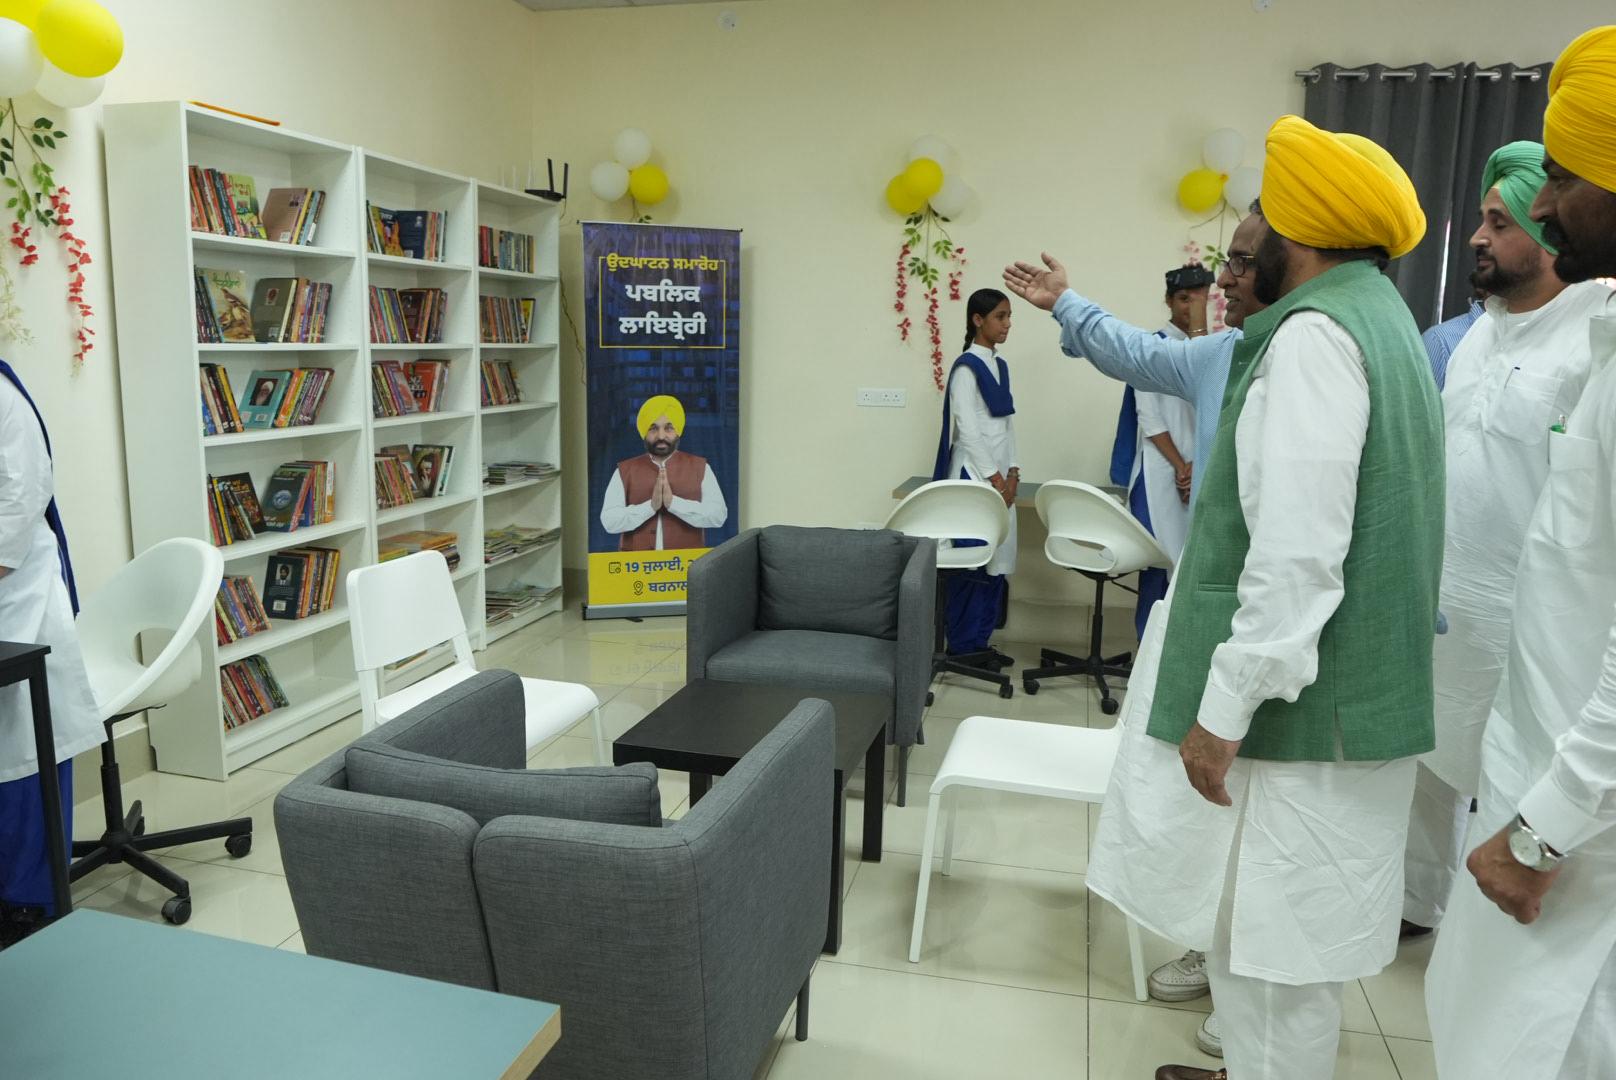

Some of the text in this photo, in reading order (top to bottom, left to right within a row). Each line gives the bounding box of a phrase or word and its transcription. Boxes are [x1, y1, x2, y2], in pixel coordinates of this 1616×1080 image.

[606, 253, 669, 271] ਉਦਘਾਟਨ
[625, 279, 700, 302] ਪਬਲਿਕ
[618, 311, 706, 340] ਲਾਇਬ੍ਰੇਰੀ
[625, 562, 640, 573] 19
[642, 556, 684, 574] ਜੁਲਾਈ,
